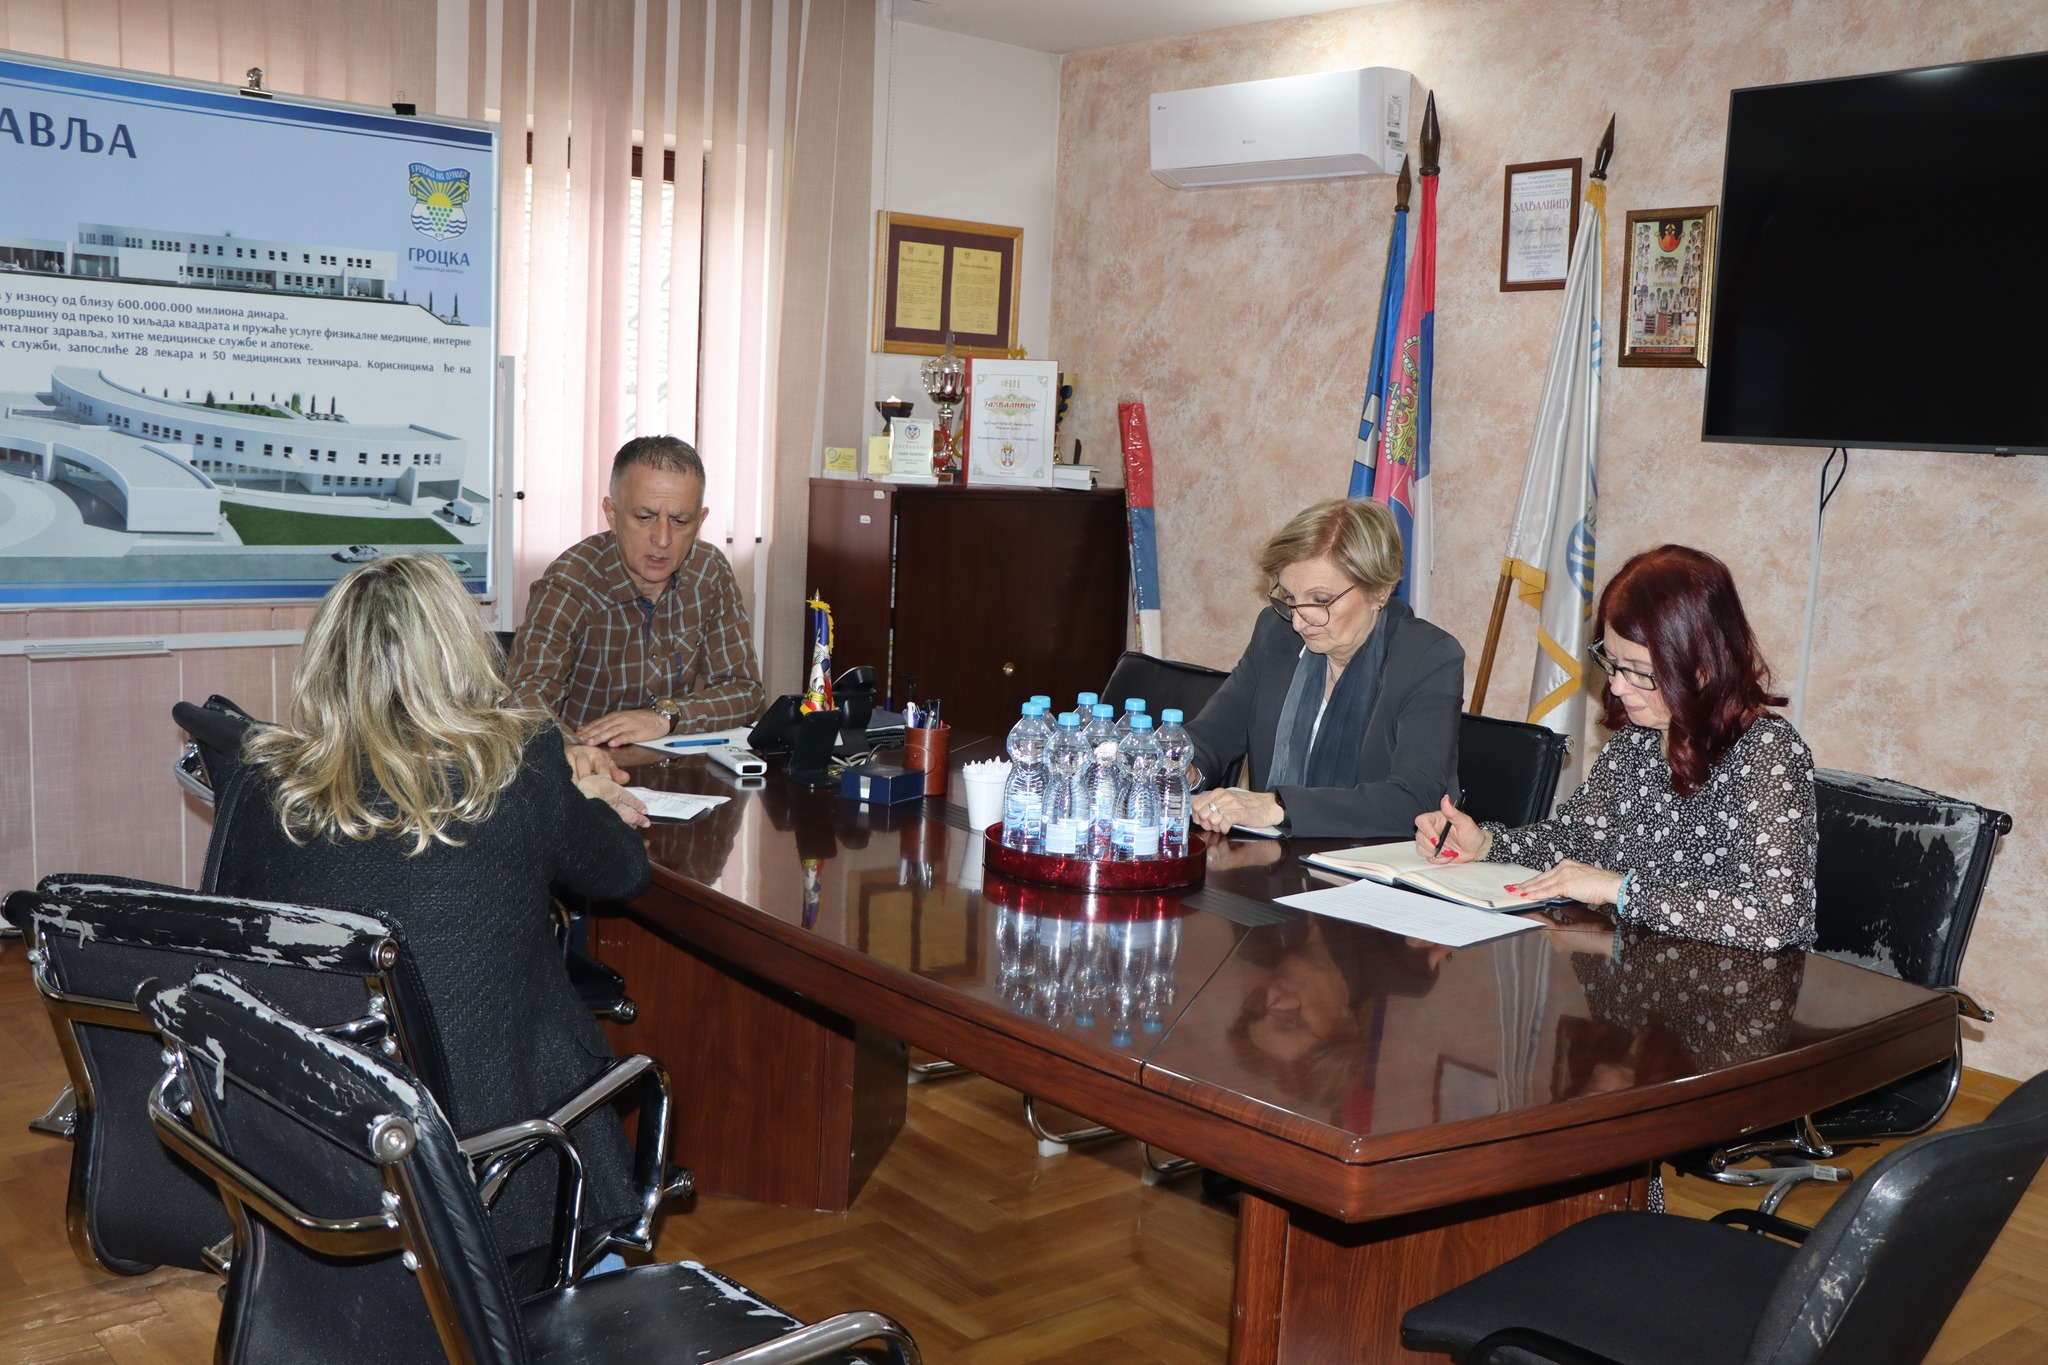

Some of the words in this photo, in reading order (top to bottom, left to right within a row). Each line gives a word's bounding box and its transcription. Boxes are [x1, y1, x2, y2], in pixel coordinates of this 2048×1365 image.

[0, 107, 137, 159] АВЉА
[1512, 198, 1571, 213] ЗАХВАЛНИЦУ
[408, 247, 470, 267] ГРОЦКА
[5, 292, 13, 301] у
[16, 292, 59, 306] износу
[62, 296, 77, 306] од
[80, 295, 114, 311] близу
[118, 299, 193, 314] 600.000.000
[196, 306, 244, 317] милиона
[247, 310, 289, 322] динара.
[52, 327, 107, 339] здравља,
[111, 331, 144, 341] хитне
[148, 333, 216, 345] медицинске
[219, 337, 258, 349] службе
[261, 340, 267, 348] и
[270, 341, 314, 351] апотеке.
[62, 312, 77, 322] од
[79, 313, 114, 325] преко
[117, 314, 130, 325] 10
[133, 316, 176, 328] хиљада
[178, 320, 230, 332] квадрата
[242, 324, 287, 336] пружаће
[290, 327, 322, 339] услуге
[324, 328, 378, 340] физикалне
[380, 334, 431, 345] медицине,
[433, 337, 472, 348] интерне
[12, 339, 61, 353] служби,
[68, 343, 129, 355] запослиће
[135, 346, 148, 356] 28
[155, 349, 194, 360] лекара
[200, 351, 207, 359] и
[213, 351, 226, 360] 50
[232, 352, 302, 365] медицинских
[307, 357, 362, 370] техничара.
[367, 360, 434, 373] Корисницима
[444, 363, 455, 373] ће
[460, 365, 472, 374] на
